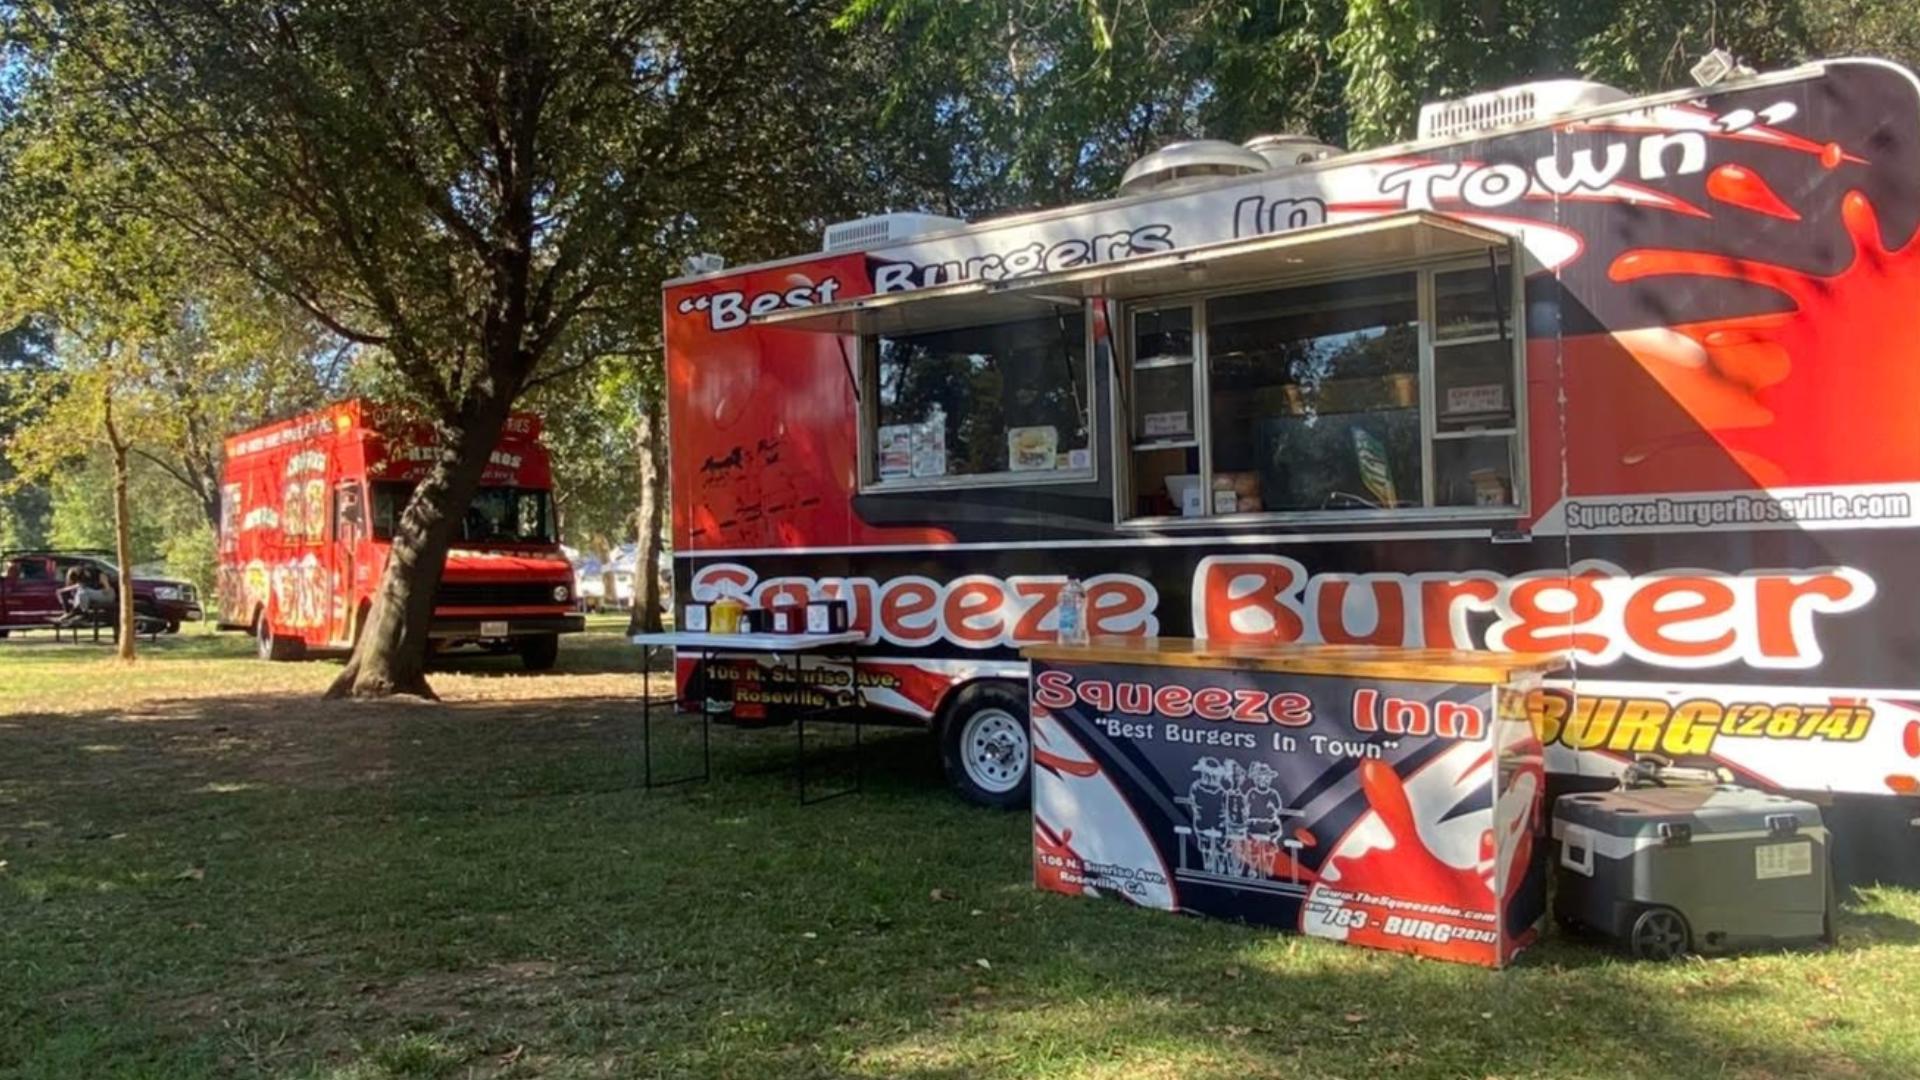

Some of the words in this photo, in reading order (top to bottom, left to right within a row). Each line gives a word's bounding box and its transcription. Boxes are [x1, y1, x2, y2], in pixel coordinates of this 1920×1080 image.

[1565, 493, 1912, 528] SqueezeBurgerRoseville.com
[1190, 553, 1878, 669] Burger
[1036, 670, 1313, 728] Squeeze
[1352, 688, 1486, 741] Inn
[1095, 717, 1154, 739] "Best
[1165, 723, 1257, 748] Burgers
[1272, 731, 1297, 752] In
